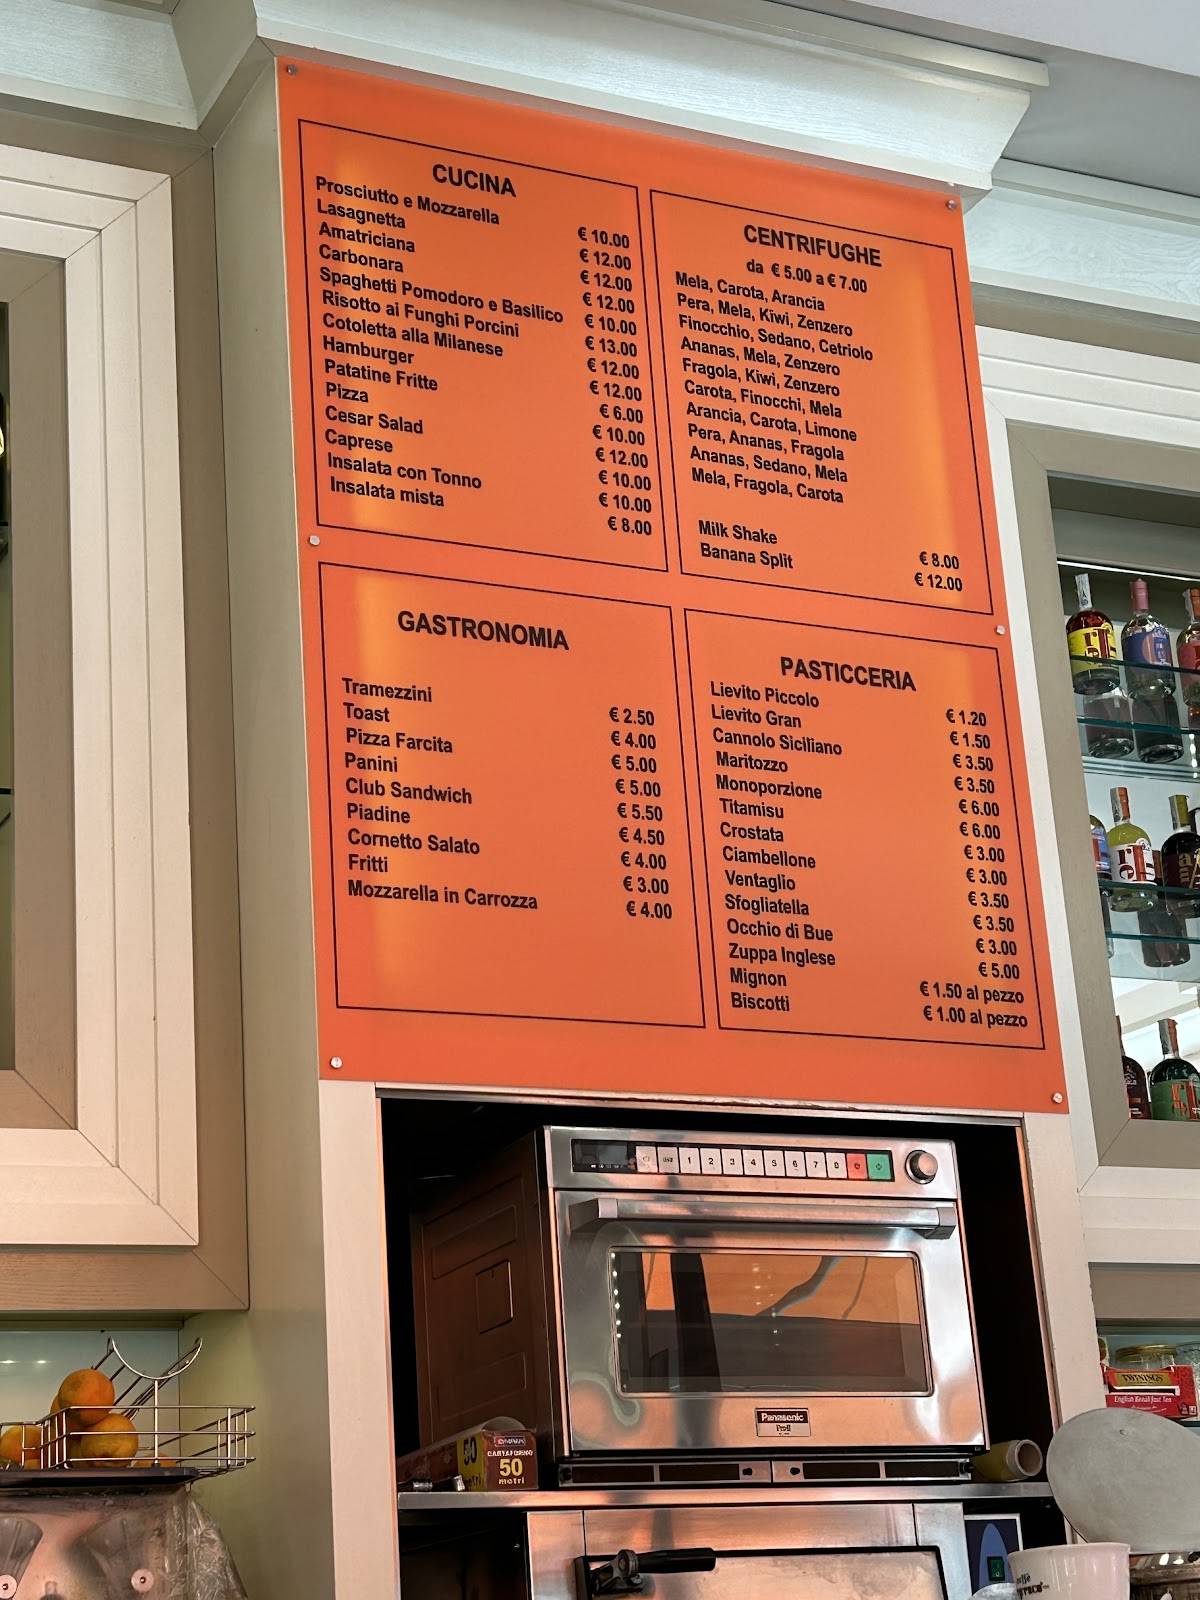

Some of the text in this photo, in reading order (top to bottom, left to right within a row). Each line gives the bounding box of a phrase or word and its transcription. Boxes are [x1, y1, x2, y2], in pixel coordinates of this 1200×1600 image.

[432, 163, 516, 197] CUCINA
[315, 175, 500, 225] Prosciutto e Mozzarella
[317, 198, 406, 229] Lasagnetta
[318, 221, 415, 253] Amatriciana
[591, 229, 630, 249] 10.00
[743, 224, 882, 267] CENTRIFUGHE
[318, 243, 404, 273] Carbonara
[746, 258, 764, 274] da
[783, 264, 812, 283] 5.00
[815, 274, 824, 286] a
[838, 275, 867, 293] 7.00
[319, 266, 563, 323] Spaghetti Pomodoro e Basilico
[675, 270, 825, 311] Mela, Carota, Arancia
[322, 289, 519, 337] Risotto ai Funghi Porcini
[596, 294, 635, 314] 12.00
[676, 292, 853, 337] Pera, Mela, Kiwi, Zenzero
[322, 312, 503, 357] Cotoletta alla Milanese
[678, 313, 873, 361] Finocchio, Sedano, Cetriolo
[322, 334, 415, 365] Hamburger
[680, 335, 840, 376] Ananas, Mela, Zenzero
[324, 358, 438, 391] Patatine Fritte
[600, 360, 640, 380] 12.00
[682, 357, 840, 397] Fragola, Kiwi, Zenzero
[325, 381, 368, 403] Pizza
[684, 379, 842, 418] Carota, Finocchi, Mela
[325, 404, 423, 434] Cesar Salad
[686, 401, 857, 442] Arancia, Carota, Limone
[324, 428, 393, 453] Caprese
[606, 426, 645, 446] 10.00
[687, 422, 844, 461] Pera, Ananas, Fragola
[327, 451, 482, 489] Insalata con Tonno
[690, 445, 848, 482] Ananas, Sedano, Mela
[330, 475, 444, 507] Insalata mista
[691, 466, 844, 503] Mela, Fragola, Carota
[612, 494, 652, 513] 10.00
[698, 519, 777, 544] Milk Shake
[700, 542, 793, 570] Banana Split
[926, 573, 963, 592] 12.00
[397, 610, 569, 650] GASTRONOMIA
[780, 656, 916, 691] PASTICCERIA
[341, 677, 432, 703] Tramezzini
[710, 680, 819, 708] Lievito Piccolo
[342, 701, 390, 723] Toast
[711, 703, 801, 728] Lievito Gran
[346, 727, 453, 753] Pizza Farcita
[712, 726, 842, 755] Cannolo Siciliano
[344, 751, 398, 772] Panini
[625, 755, 657, 774] 5.00
[715, 750, 788, 773] Maritozzo
[964, 754, 994, 772] 3.50
[345, 776, 472, 804] Club Sandwich
[715, 773, 822, 799] Monoporzione
[346, 802, 410, 824] Piadine
[718, 797, 784, 819] Titamisu
[347, 827, 480, 855] Cornetto Salato
[632, 827, 665, 846] 4.50
[719, 821, 784, 842] Crostata
[971, 822, 1001, 840] 6.00
[348, 853, 388, 873] Fritti
[722, 845, 816, 869] Ciambellone
[724, 869, 796, 893] Ventaglio
[347, 879, 538, 910] Mozzarella in Carrozza
[724, 893, 810, 916] Sfogliatella
[980, 891, 1009, 909] 3.50
[640, 901, 672, 919] 4.00
[726, 917, 833, 941] Occhio di Bue
[728, 942, 836, 968] Zuppa Inglese
[729, 966, 787, 989] Mignon
[991, 962, 1020, 980] 5.00
[730, 991, 790, 1012] Biscotti
[761, 1412, 804, 1422] Panasonic
[499, 1458, 523, 1477] 50
